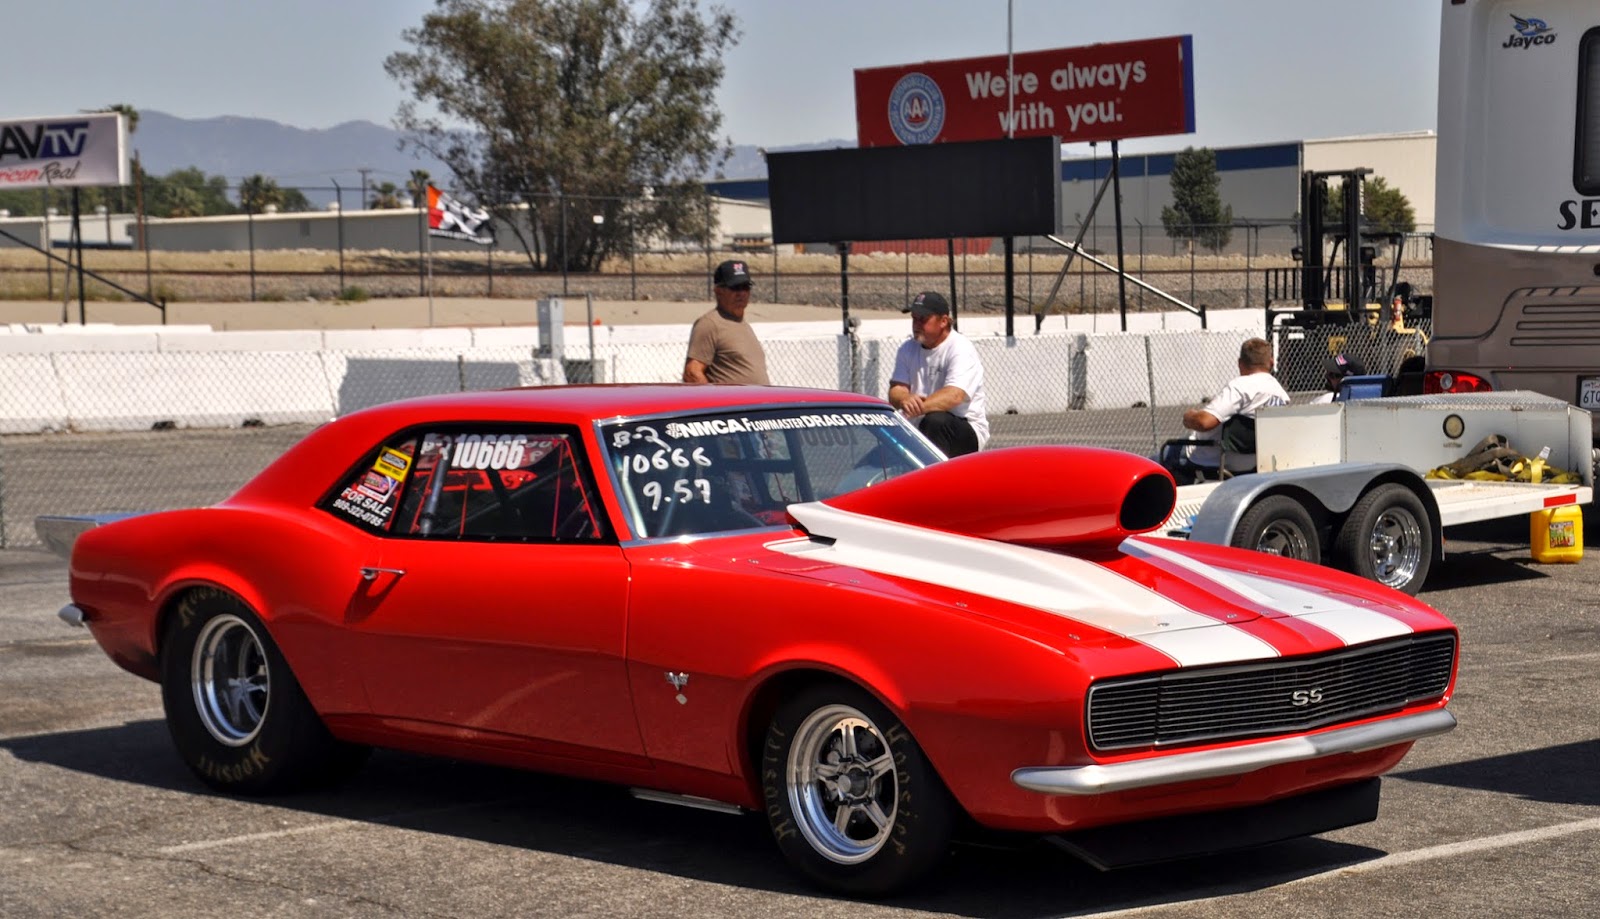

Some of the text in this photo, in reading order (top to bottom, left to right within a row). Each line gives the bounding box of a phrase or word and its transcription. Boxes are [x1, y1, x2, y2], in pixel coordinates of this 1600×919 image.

[1502, 34, 1556, 50] Jayco
[1051, 60, 1147, 92] always
[904, 97, 930, 119] AAA
[998, 101, 1055, 133] with
[38, 161, 82, 186] Real
[680, 413, 896, 439] NMCA FLOWMASTER DRAG RACING
[451, 433, 528, 470] 10666
[622, 446, 713, 481] 10666
[340, 486, 366, 505] FOR
[361, 497, 393, 518] SALE
[1291, 687, 1323, 707] SS
